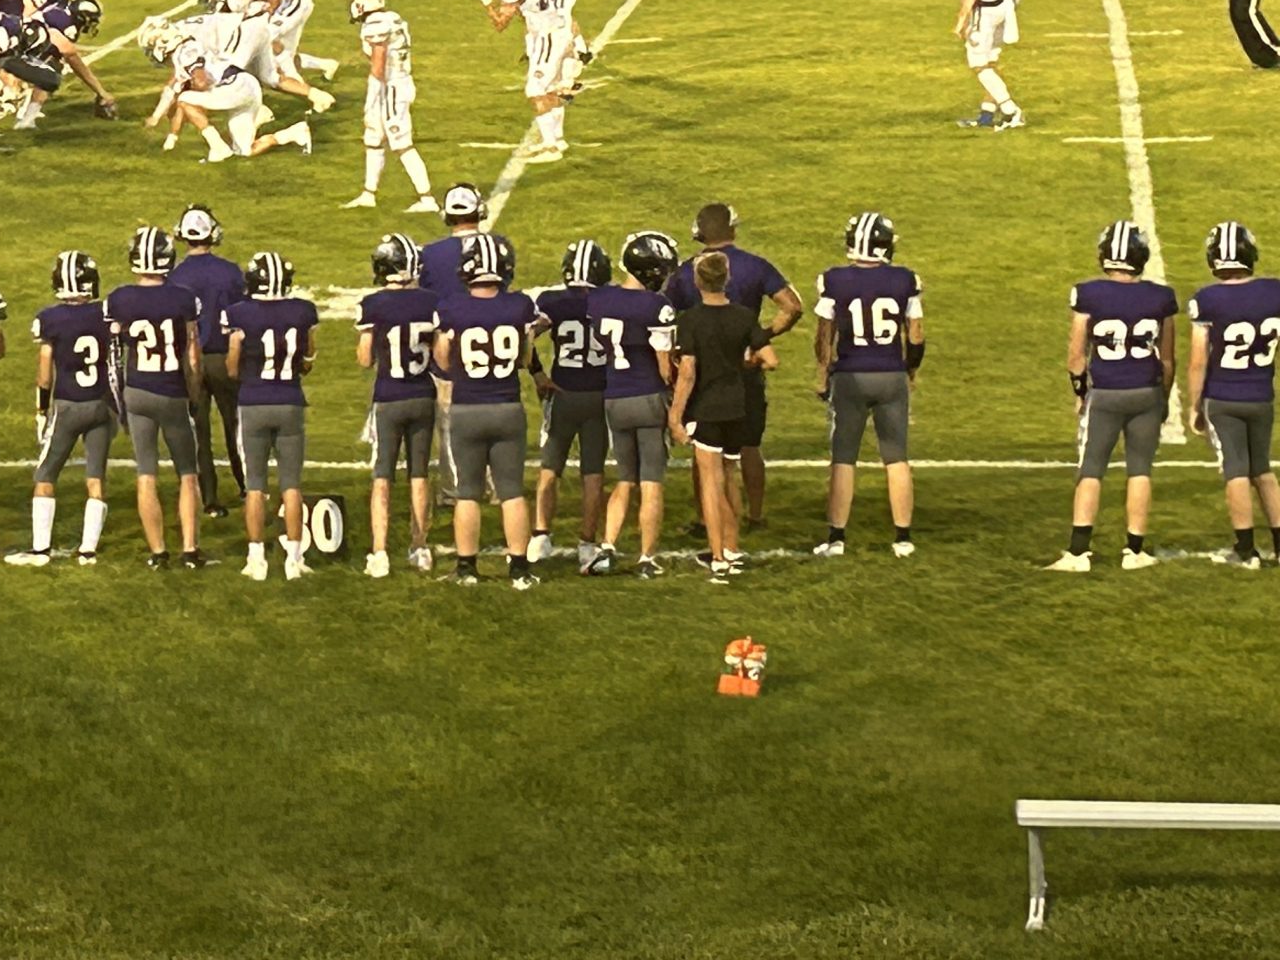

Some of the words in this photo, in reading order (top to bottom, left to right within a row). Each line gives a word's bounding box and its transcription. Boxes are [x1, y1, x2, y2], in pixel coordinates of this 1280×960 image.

[129, 318, 179, 373] 21
[600, 318, 631, 370] 7
[848, 297, 900, 347] 16
[74, 336, 100, 388] 3
[260, 327, 297, 381] 11
[386, 321, 431, 379] 15
[460, 324, 520, 379] 69
